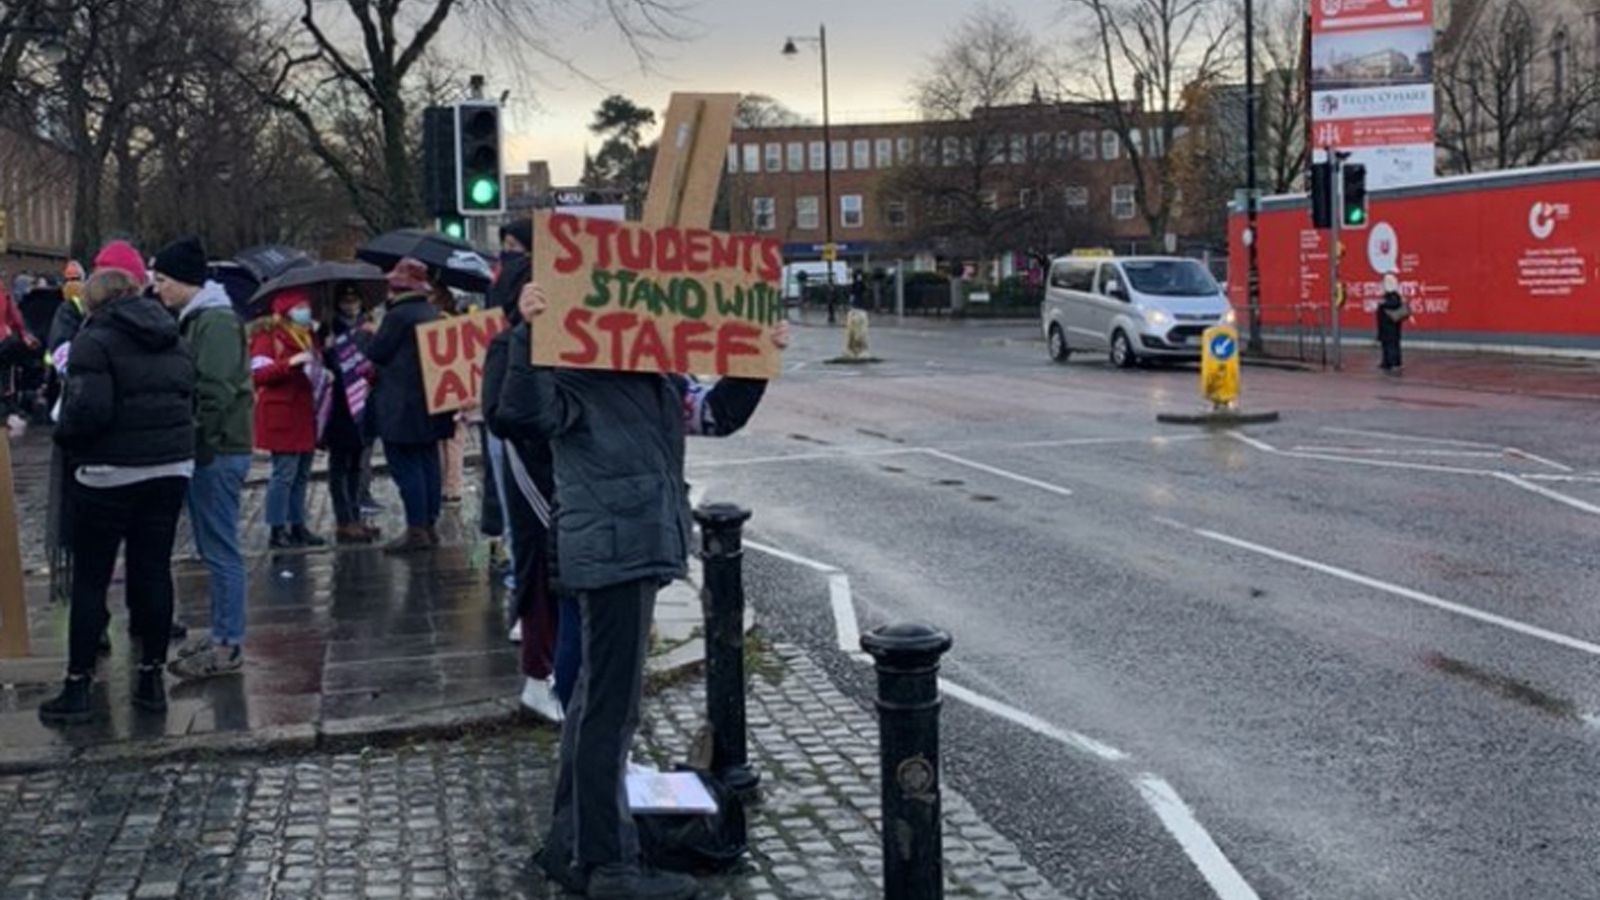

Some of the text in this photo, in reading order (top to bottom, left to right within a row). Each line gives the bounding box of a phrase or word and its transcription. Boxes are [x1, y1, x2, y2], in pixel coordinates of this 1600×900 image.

[548, 213, 784, 282] STUDENTS
[583, 268, 784, 326] STAND WITH
[559, 307, 763, 375] STAFF
